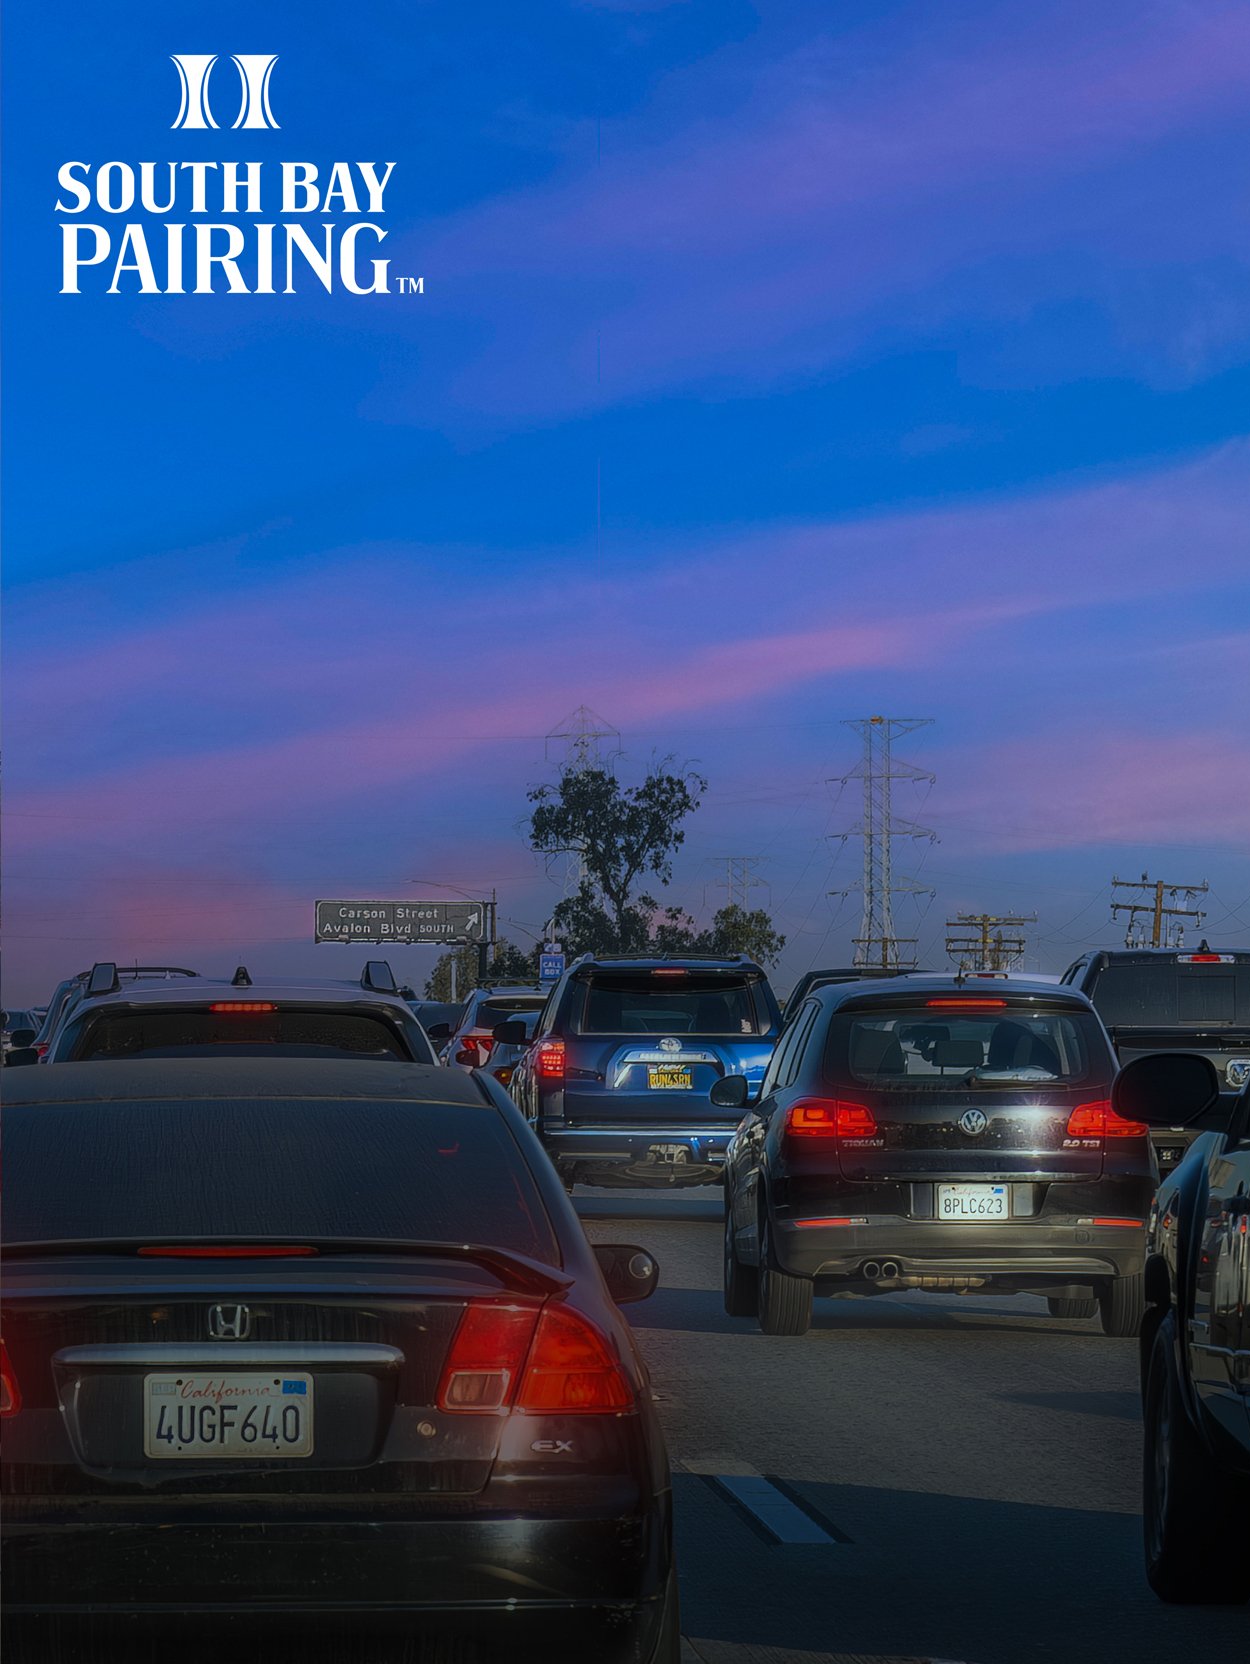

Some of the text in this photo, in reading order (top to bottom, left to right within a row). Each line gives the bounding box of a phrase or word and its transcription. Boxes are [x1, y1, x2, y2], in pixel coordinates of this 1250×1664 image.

[339, 907, 439, 919] Carson Street
[323, 923, 454, 934] Avalon Blvd SOUTH
[944, 1198, 1003, 1213] 8PLC623
[180, 1379, 271, 1403] California
[156, 1405, 300, 1444] 4UGF640
[531, 1440, 573, 1453] EX
